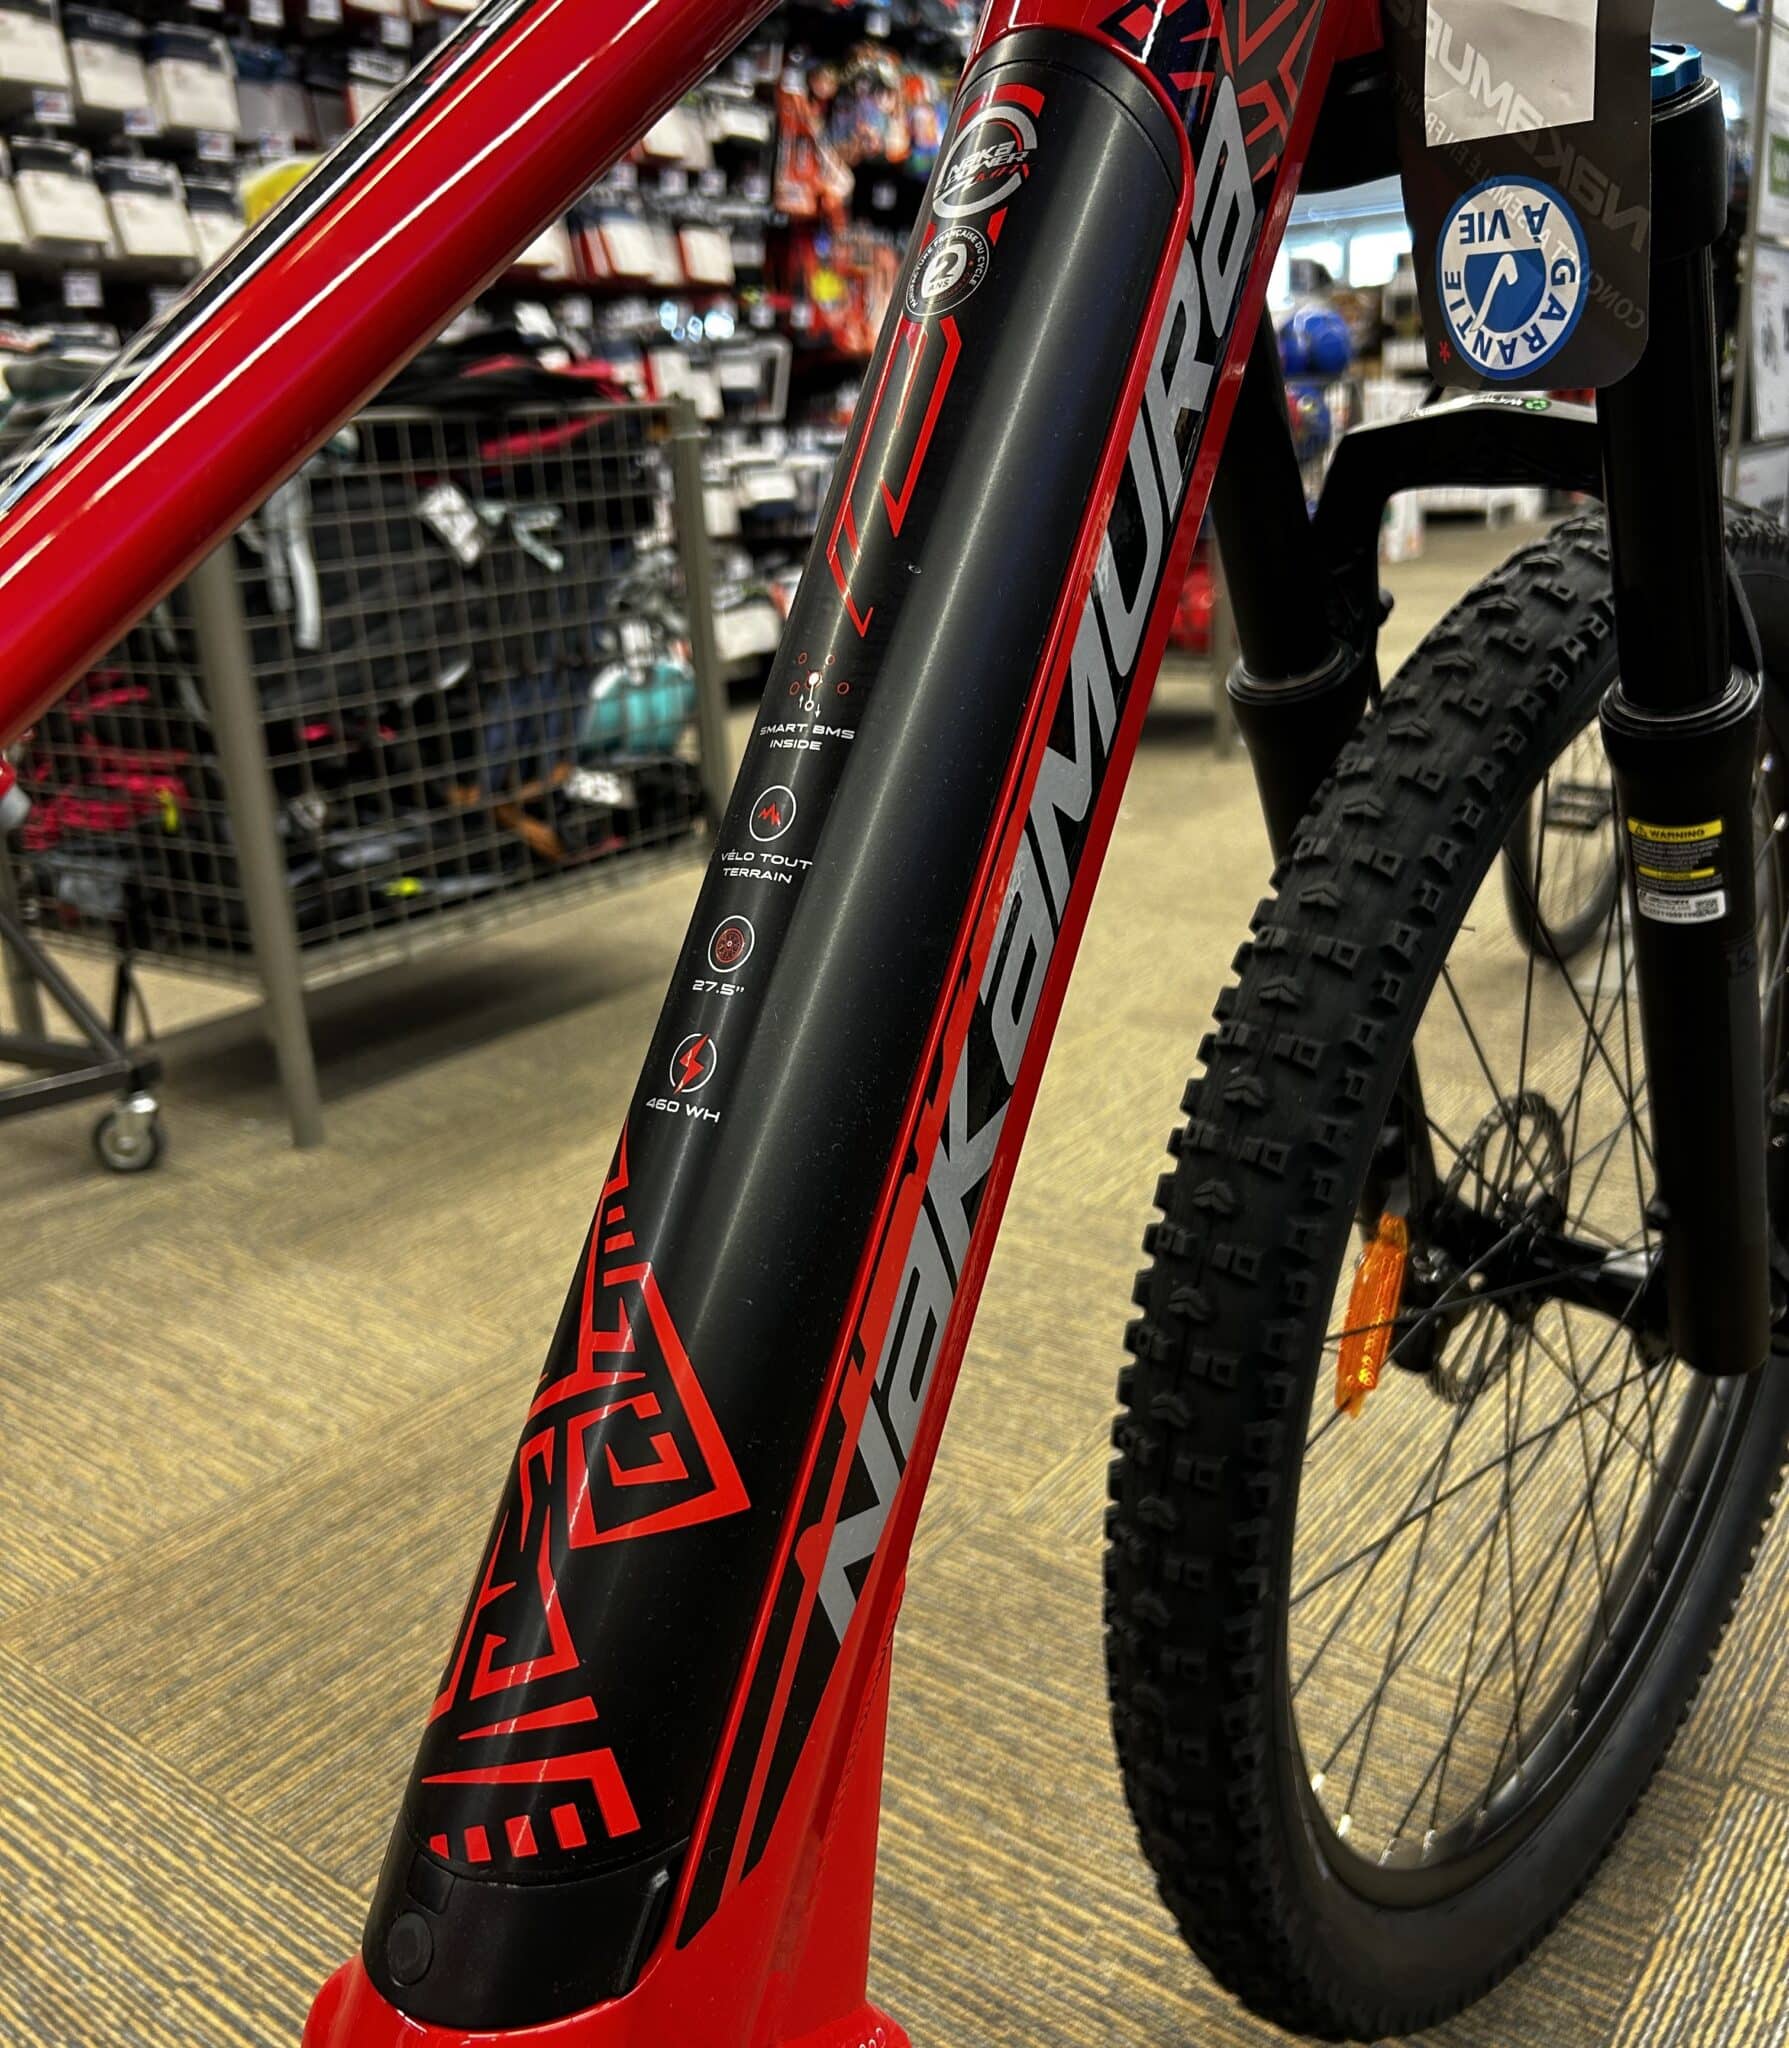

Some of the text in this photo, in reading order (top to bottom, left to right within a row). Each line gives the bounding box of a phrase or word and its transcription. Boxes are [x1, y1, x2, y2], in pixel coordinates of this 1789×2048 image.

[1459, 202, 1551, 245] À VIE
[974, 240, 986, 254] DU
[929, 251, 959, 283] 2
[968, 256, 986, 286] CYCLE
[927, 277, 955, 291] ANS
[1445, 257, 1577, 366] GARANTIE
[760, 723, 856, 740] SMART BMS
[769, 739, 823, 751] INSIDE
[1649, 829, 1705, 839] WARNING
[721, 848, 814, 870] VÉLO TOUT
[722, 867, 793, 884] TERRAIN
[645, 1097, 721, 1123] 460 WH
